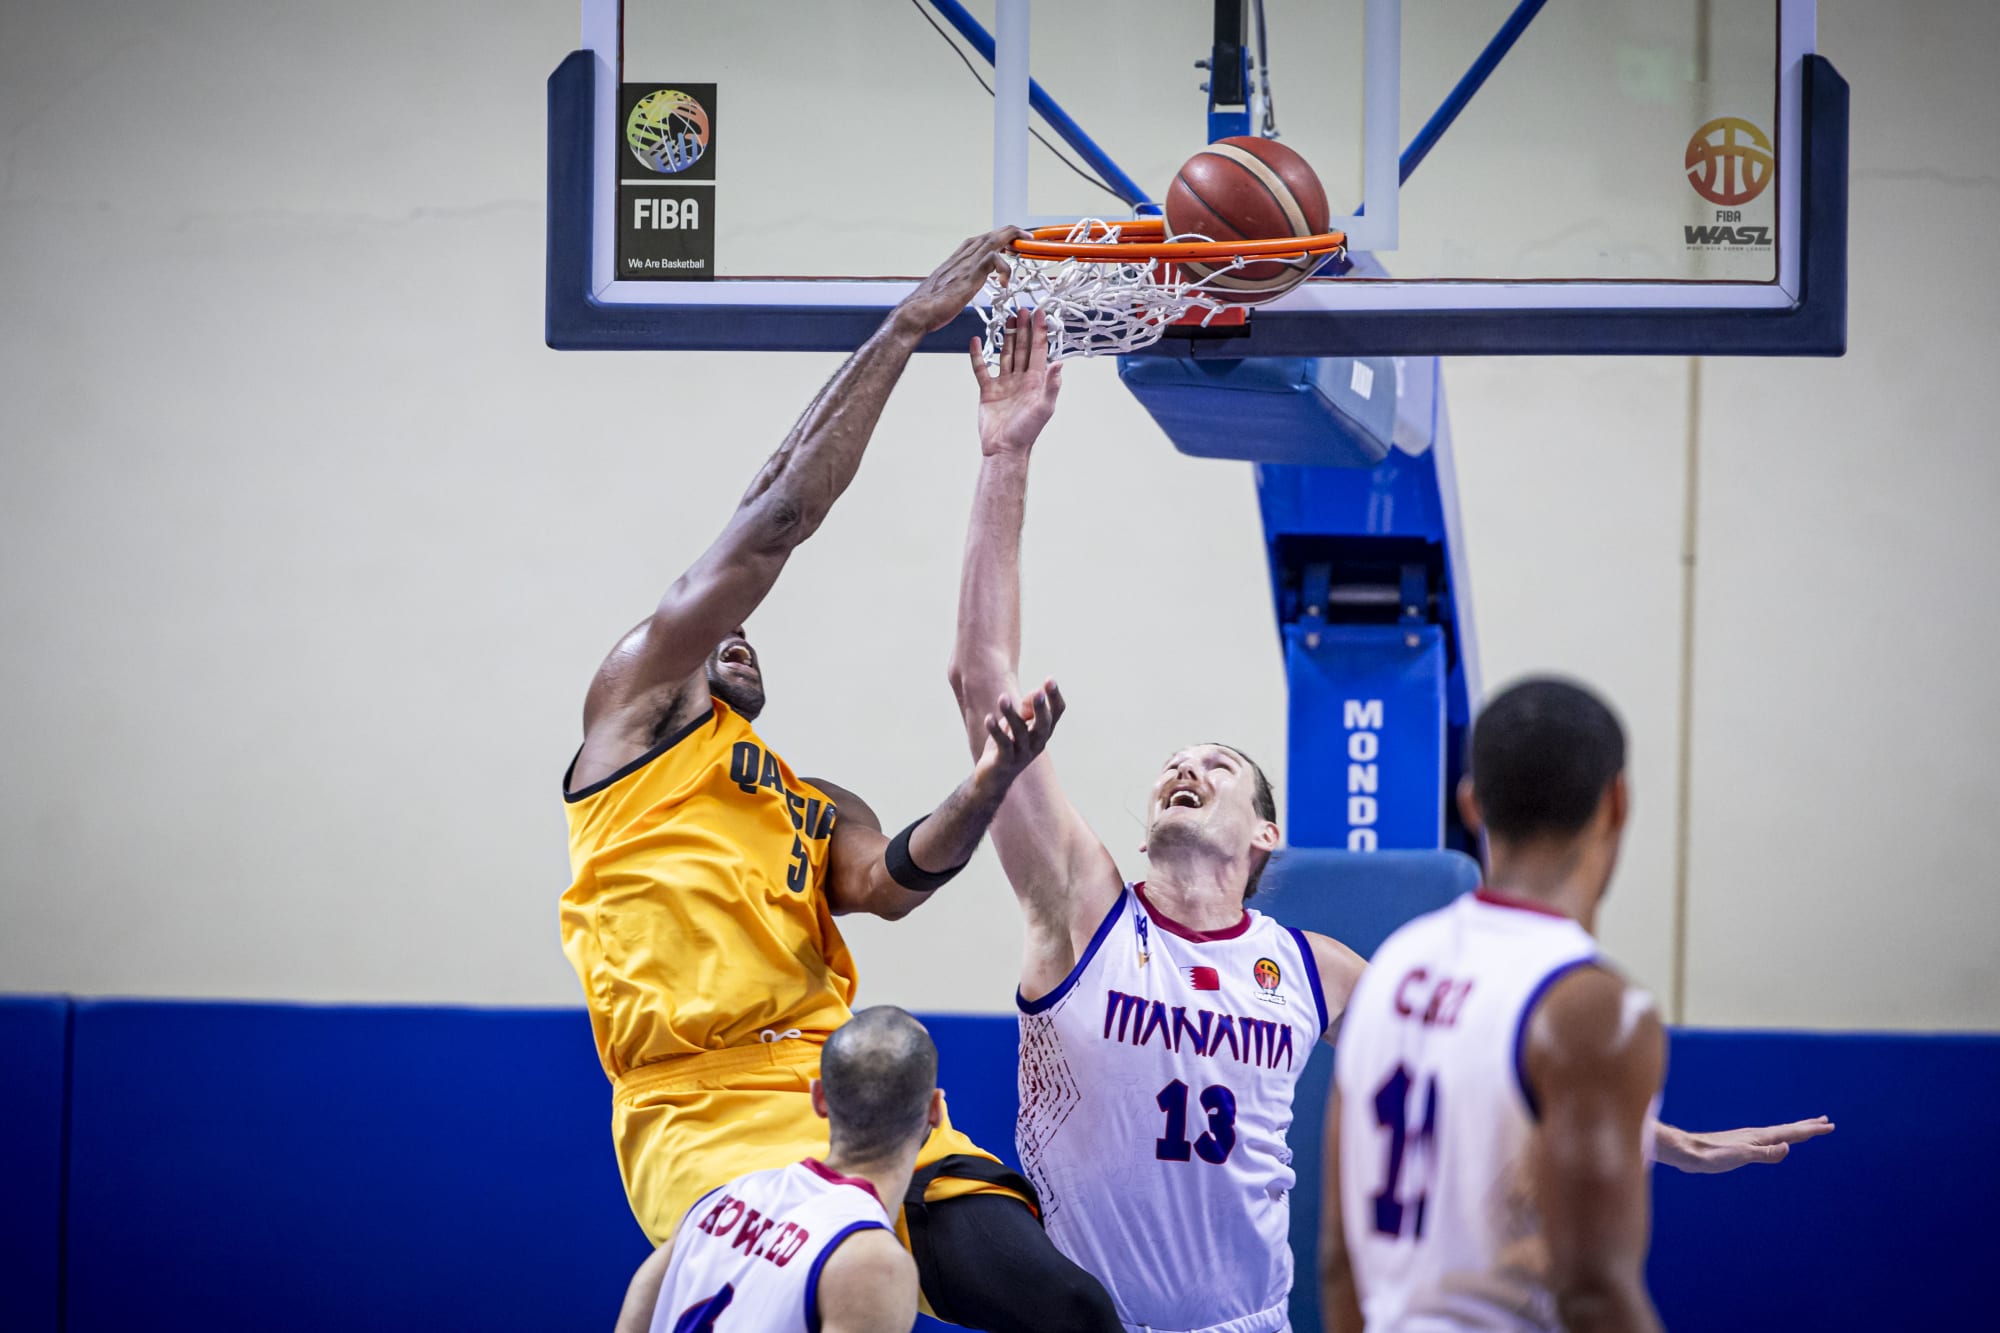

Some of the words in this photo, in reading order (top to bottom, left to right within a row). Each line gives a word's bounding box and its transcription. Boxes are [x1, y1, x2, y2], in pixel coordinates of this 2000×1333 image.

[634, 198, 699, 229] FIBA
[1716, 210, 1741, 222] FIBA
[628, 258, 643, 269] We
[645, 258, 660, 269] Are
[661, 258, 704, 269] Basketball
[1343, 699, 1383, 852] MONDO
[786, 832, 809, 893] 5
[1104, 990, 1294, 1072] MANAMA
[1155, 1078, 1237, 1165] 13
